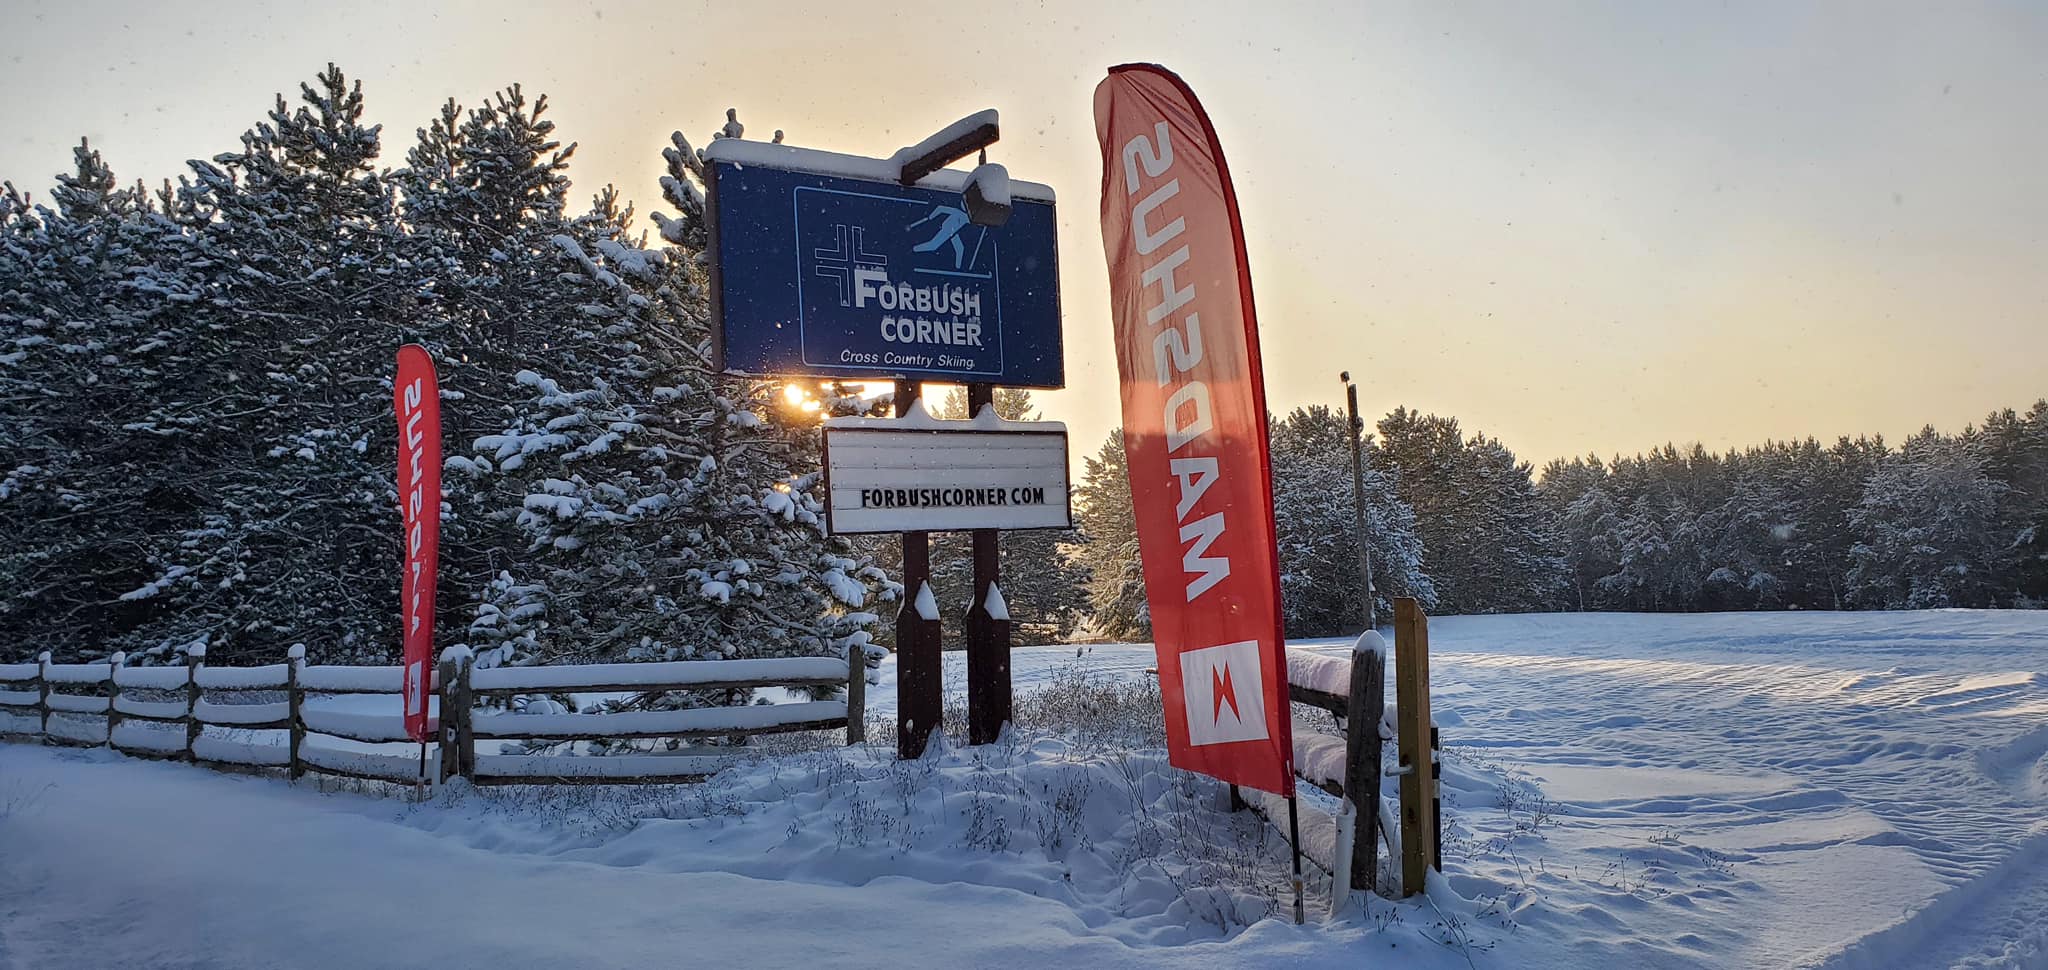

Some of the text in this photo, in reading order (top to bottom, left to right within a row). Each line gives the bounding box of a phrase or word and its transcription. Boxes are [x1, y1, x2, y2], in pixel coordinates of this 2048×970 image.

[854, 268, 981, 317] FORBUSH
[880, 317, 983, 346] CORNER
[840, 349, 879, 363] Cross
[884, 351, 933, 368] Country
[861, 488, 1007, 507] FORBUSHCORNER
